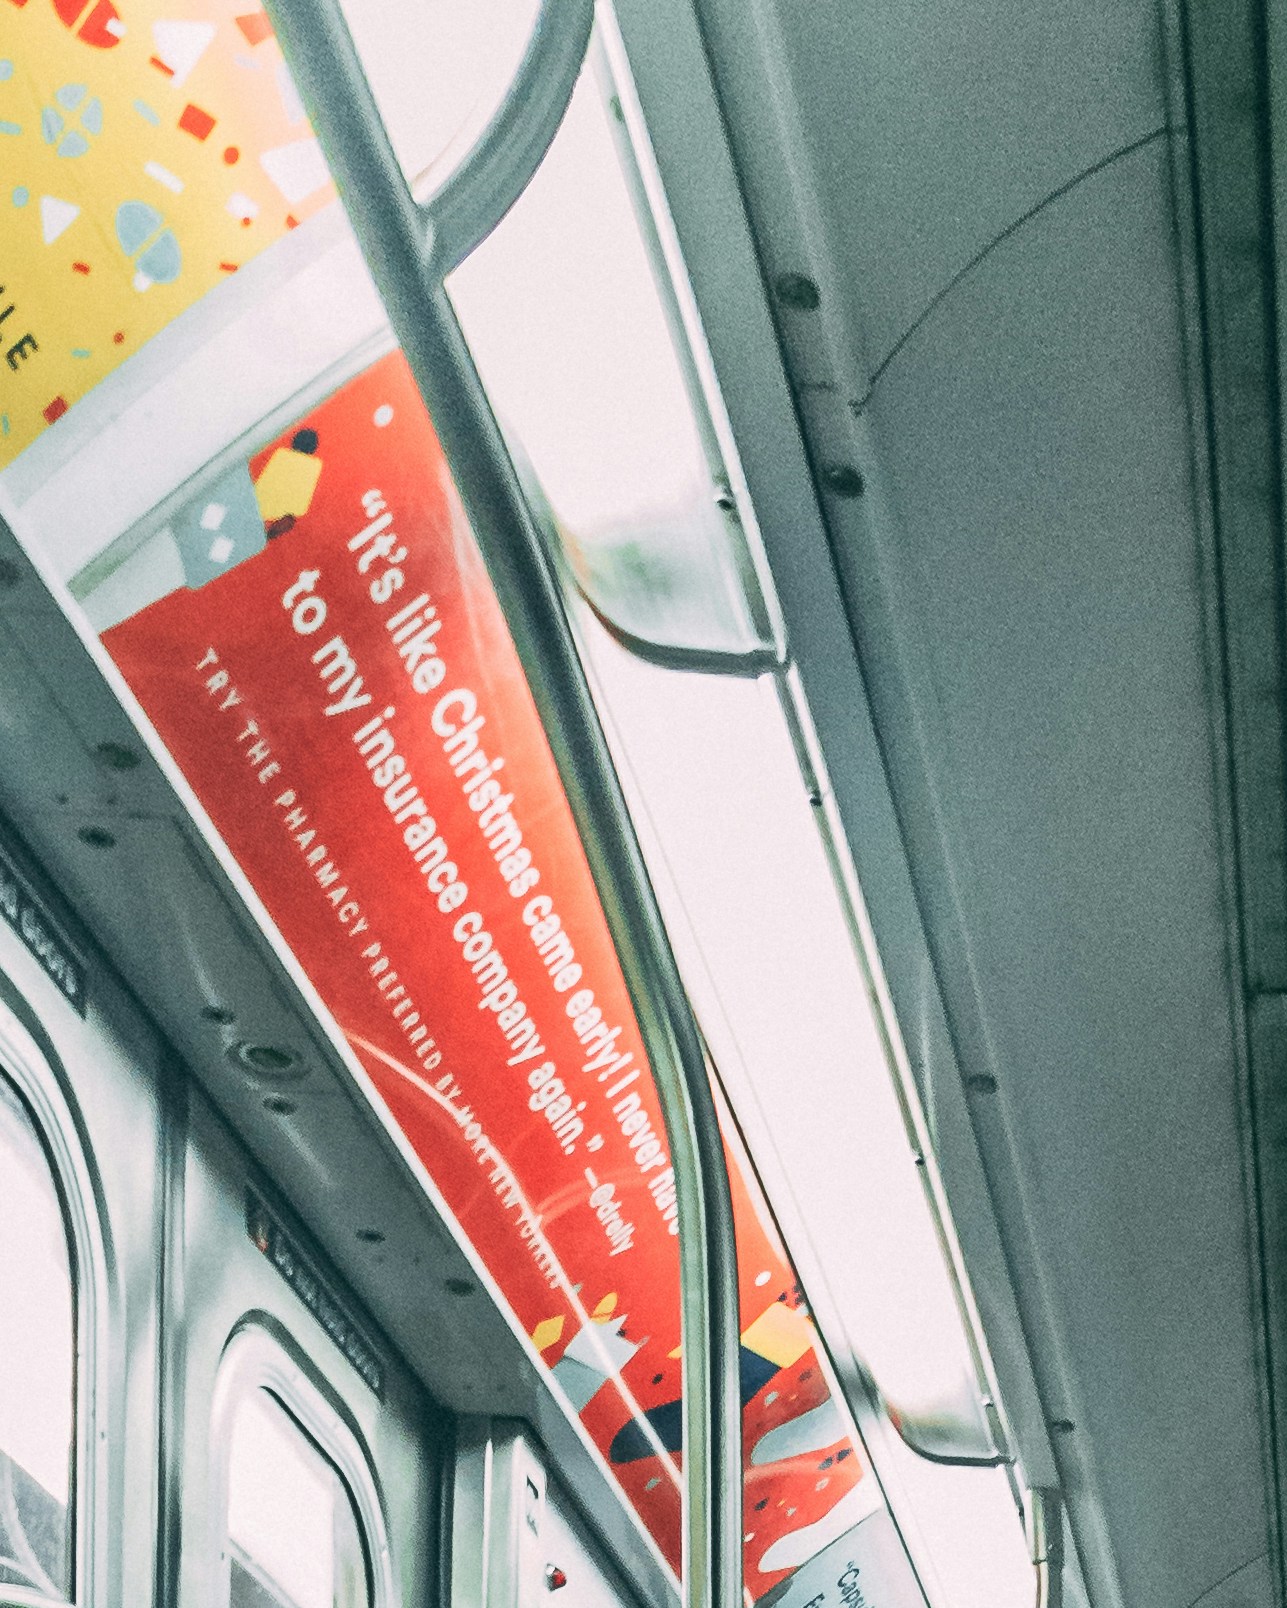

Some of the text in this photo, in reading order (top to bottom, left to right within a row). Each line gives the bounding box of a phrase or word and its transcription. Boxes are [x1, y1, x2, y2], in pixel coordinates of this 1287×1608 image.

[347, 489, 408, 604] “It’s
[386, 593, 446, 694] like
[281, 568, 329, 635] to
[311, 635, 373, 717] my
[354, 705, 469, 914] insurance
[452, 911, 546, 1066] company
[431, 688, 540, 897] Christmas
[195, 645, 245, 715] TRY
[236, 718, 281, 785] THE
[274, 789, 370, 938] PHARMACY
[360, 941, 443, 1070] PREFERRED
[436, 1072, 464, 1104] BY
[522, 894, 583, 992] came
[566, 989, 633, 1083] early!
[607, 1069, 640, 1098] I
[613, 1092, 667, 1174] never
